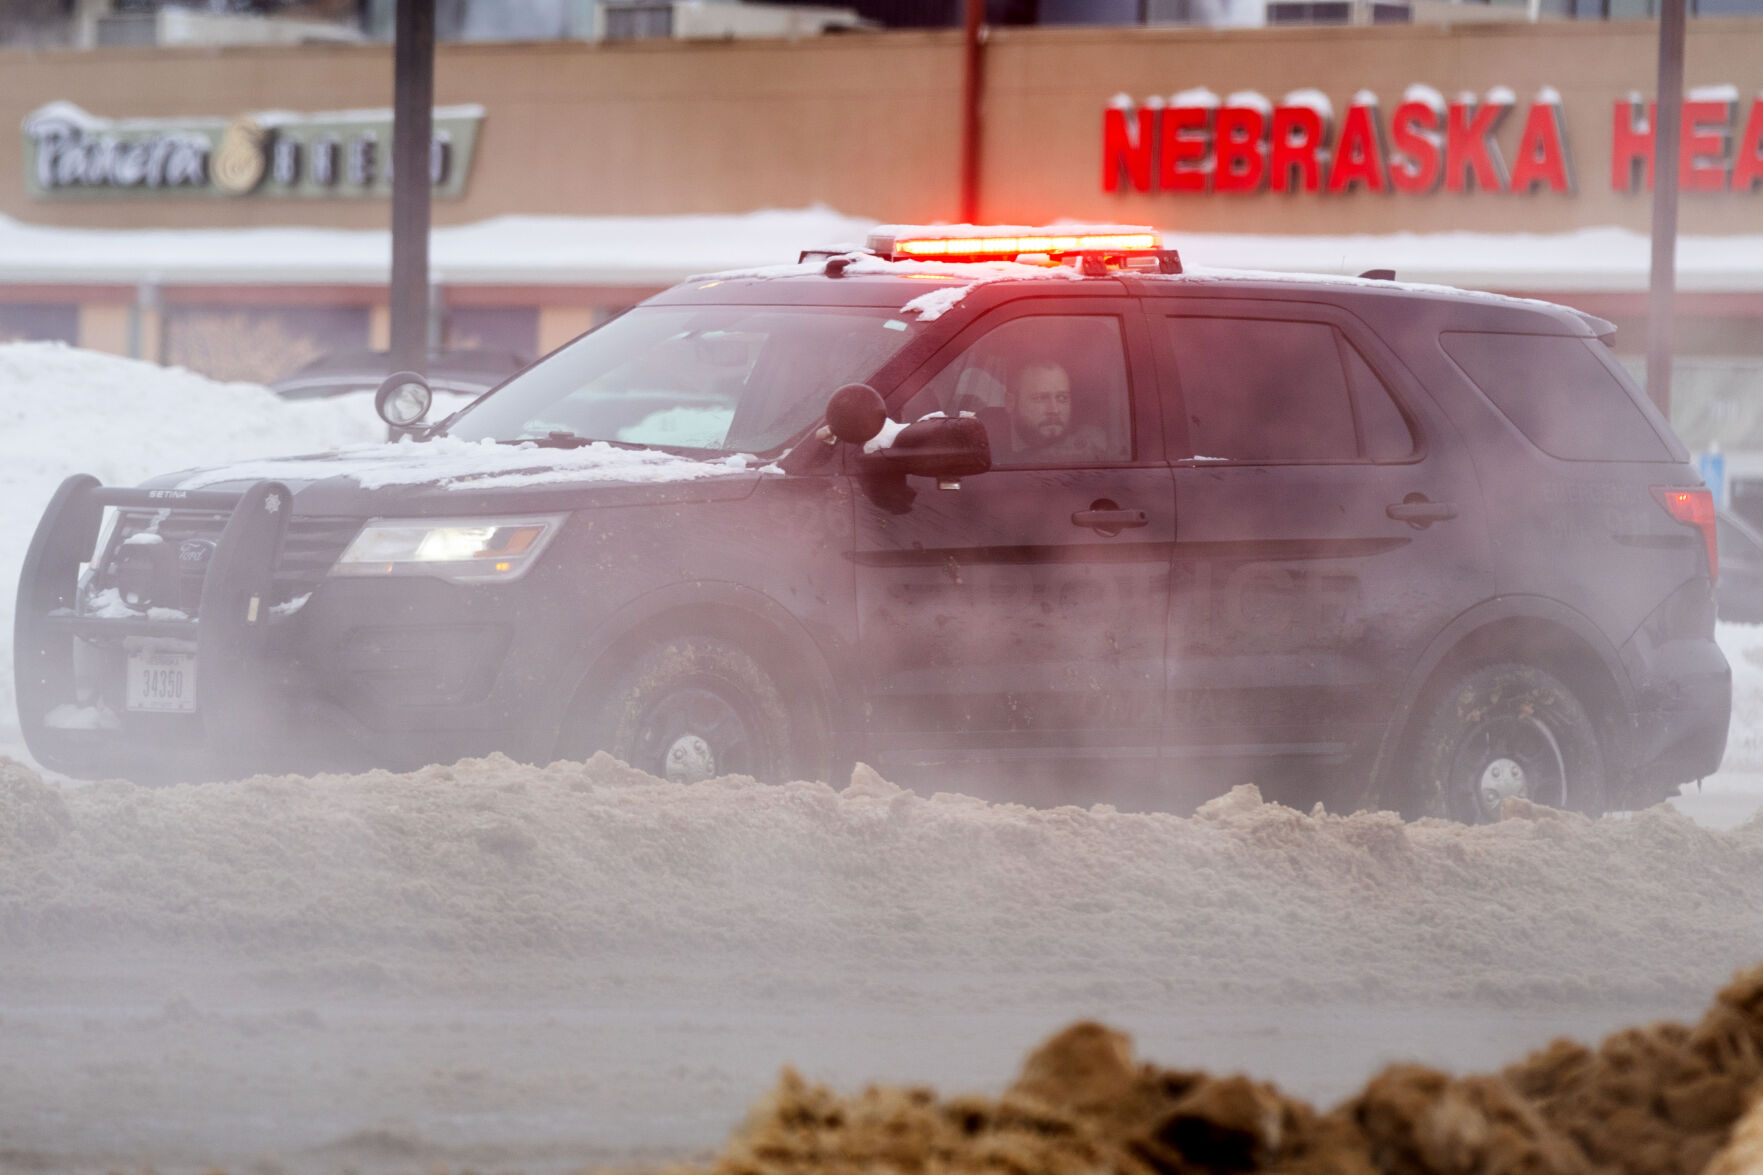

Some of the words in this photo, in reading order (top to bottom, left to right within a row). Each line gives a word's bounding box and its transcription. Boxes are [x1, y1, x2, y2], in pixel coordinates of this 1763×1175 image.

[1101, 100, 1573, 194] NEBRASKA
[149, 490, 187, 498] SETINA
[143, 669, 183, 699] 34350
